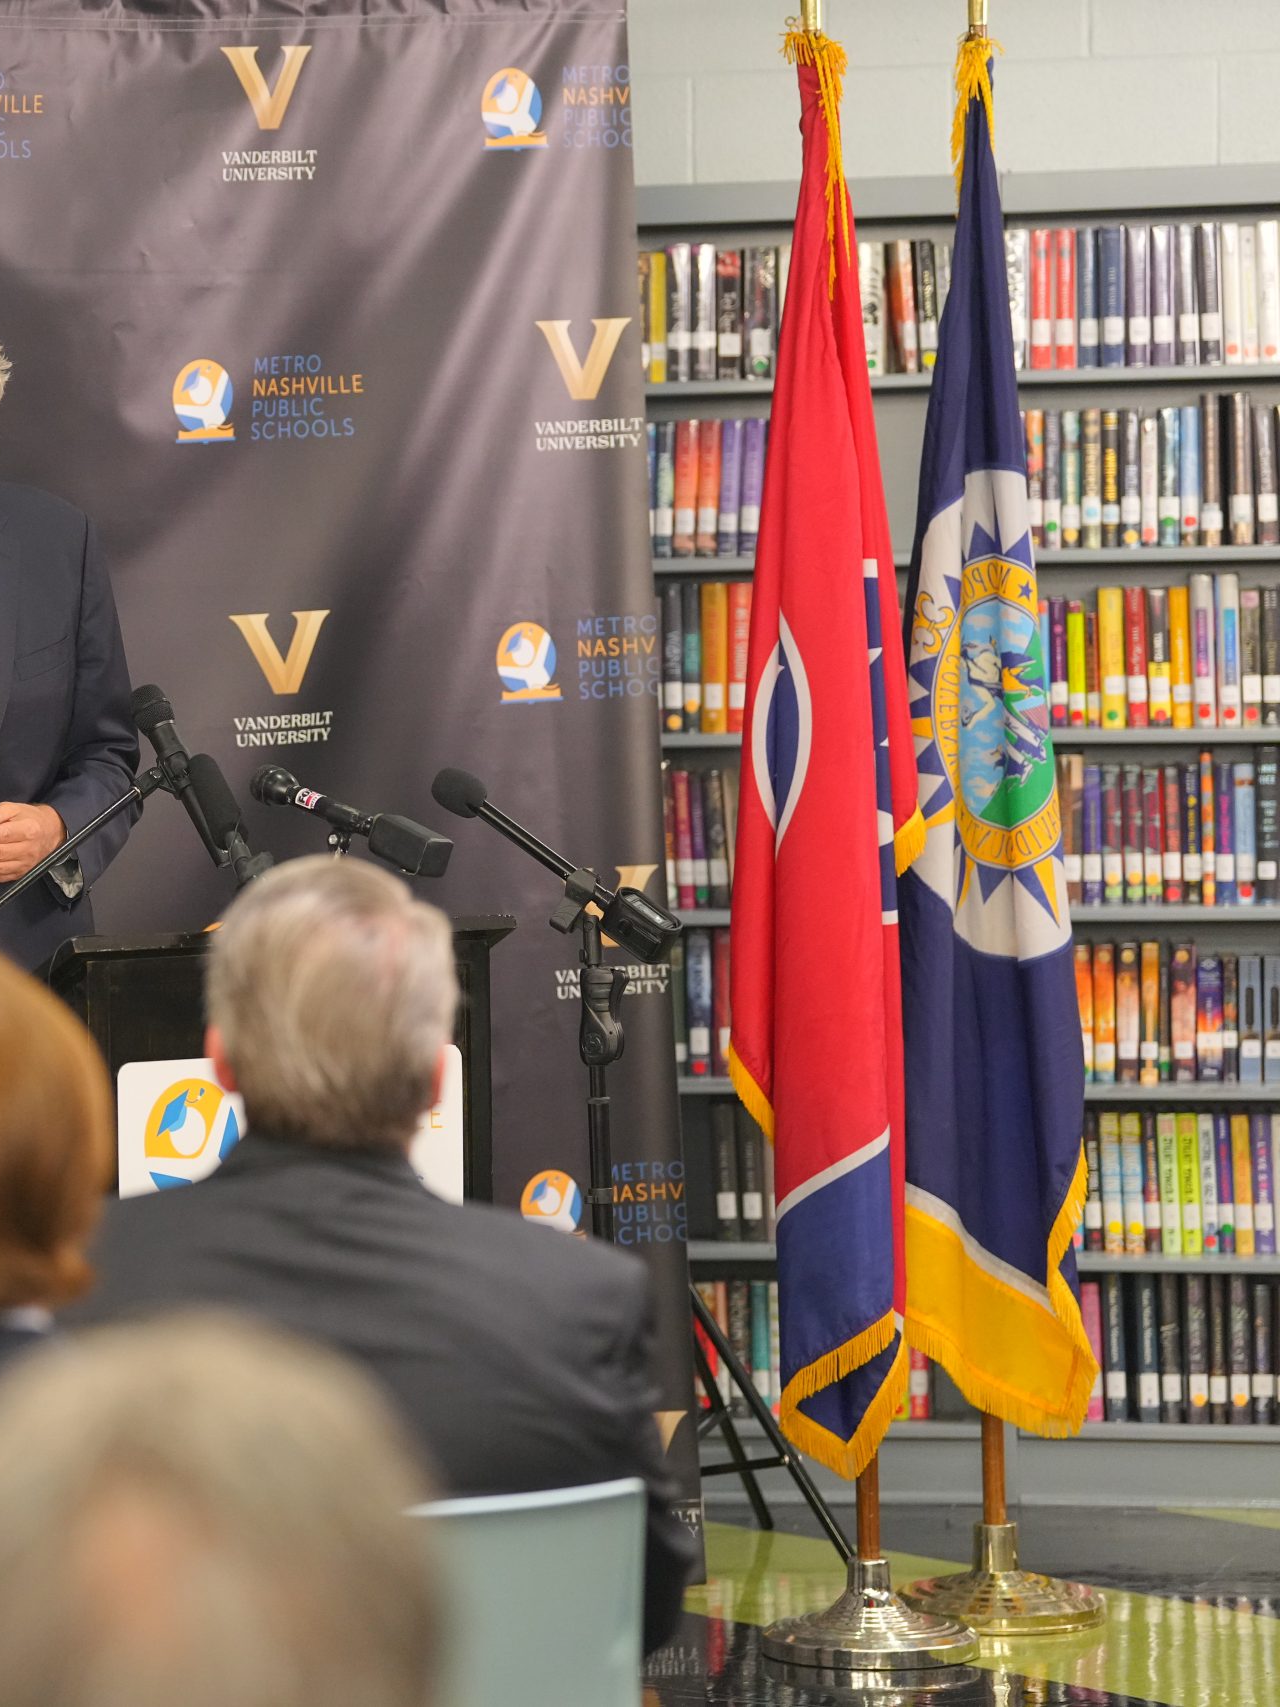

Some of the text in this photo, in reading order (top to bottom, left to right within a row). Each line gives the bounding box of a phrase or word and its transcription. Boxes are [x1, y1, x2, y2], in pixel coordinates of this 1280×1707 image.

[562, 64, 630, 84] METRO
[220, 45, 313, 130] V
[222, 150, 317, 165] VANDERBILT
[222, 166, 316, 182] UNIVERSITY
[254, 354, 322, 374] METRO
[535, 317, 632, 400] V
[252, 374, 364, 397] NASHVILLE
[251, 398, 324, 418] PUBLIC
[250, 418, 355, 440] SCHOOLS
[535, 417, 643, 435] VANDERBILT
[536, 433, 642, 451] UNIVERSITY
[229, 609, 331, 695] V
[233, 711, 333, 732] VANDERBILT
[236, 728, 331, 748] UNIVERSITY
[613, 1202, 687, 1224] UBLIC
